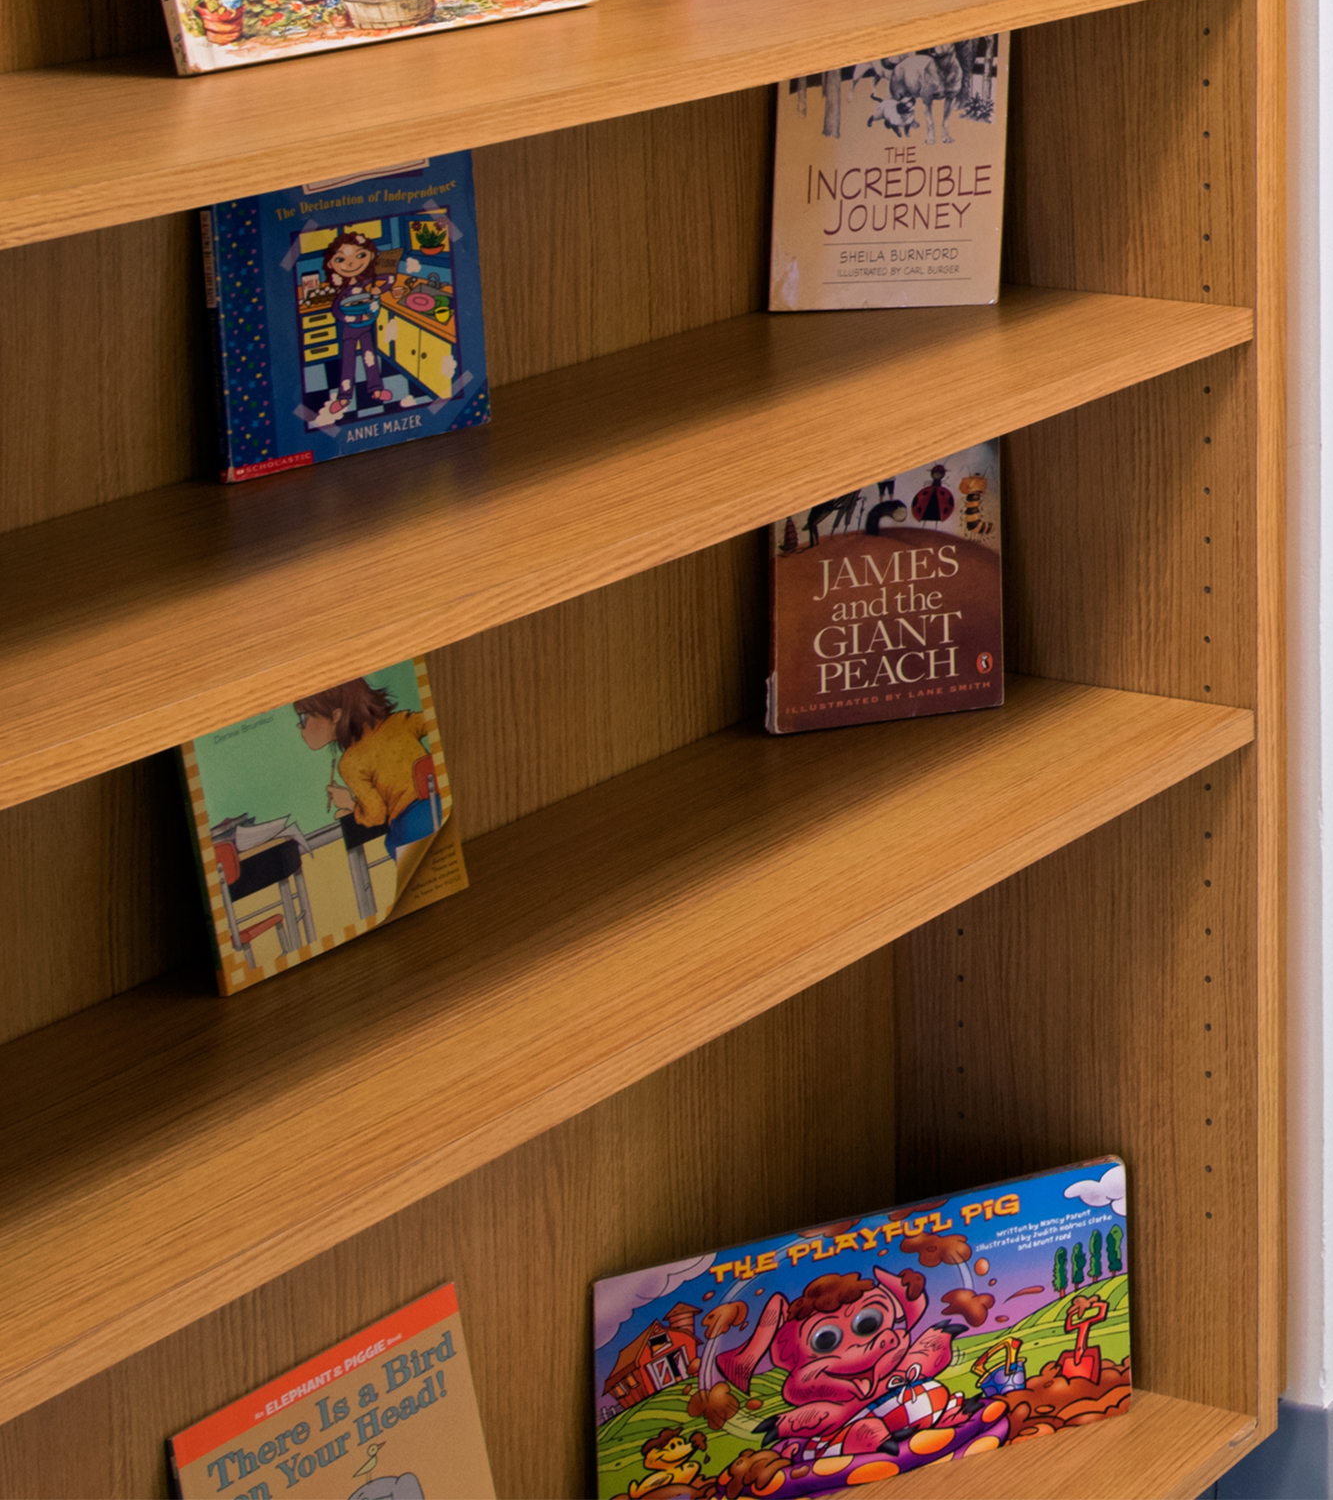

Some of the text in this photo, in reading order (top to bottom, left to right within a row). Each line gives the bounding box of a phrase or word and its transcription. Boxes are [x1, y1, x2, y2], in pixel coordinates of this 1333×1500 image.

[885, 146, 916, 163] THE
[275, 180, 457, 221] The Declaration of Independence
[807, 164, 992, 204] INCREDIBLE
[823, 199, 971, 236] JOURNEY
[837, 265, 959, 277] ILLUSTRATED BY CARL BURGER
[840, 247, 959, 263] SHEILA BURNFORD
[302, 278, 319, 288] MILK
[346, 415, 422, 443] ANNE MAZER
[245, 452, 311, 474] SCHOLASTIC
[813, 545, 960, 601] JAMES
[831, 584, 943, 622] and the
[813, 610, 963, 660] GIANT
[816, 646, 960, 695] PEACH
[785, 681, 991, 715] ILLUSTRATED BY LANE SMITH
[1020, 1234, 1031, 1243] by
[1033, 1227, 1059, 1239] Judith
[1028, 1223, 1039, 1232] by
[1040, 1217, 1065, 1228] Nancy
[1066, 1209, 1091, 1221] Parent
[709, 1250, 779, 1284] THE
[788, 1212, 953, 1269] PLAYFUL
[1018, 1242, 1032, 1251] and
[265, 1369, 333, 1417] ELEPHANT
[333, 1367, 343, 1379] &
[343, 1339, 387, 1372] PIGGIE
[207, 1330, 457, 1493] There Is a Bird
[275, 1432, 351, 1489] Your
[353, 1370, 448, 1447] Head!
